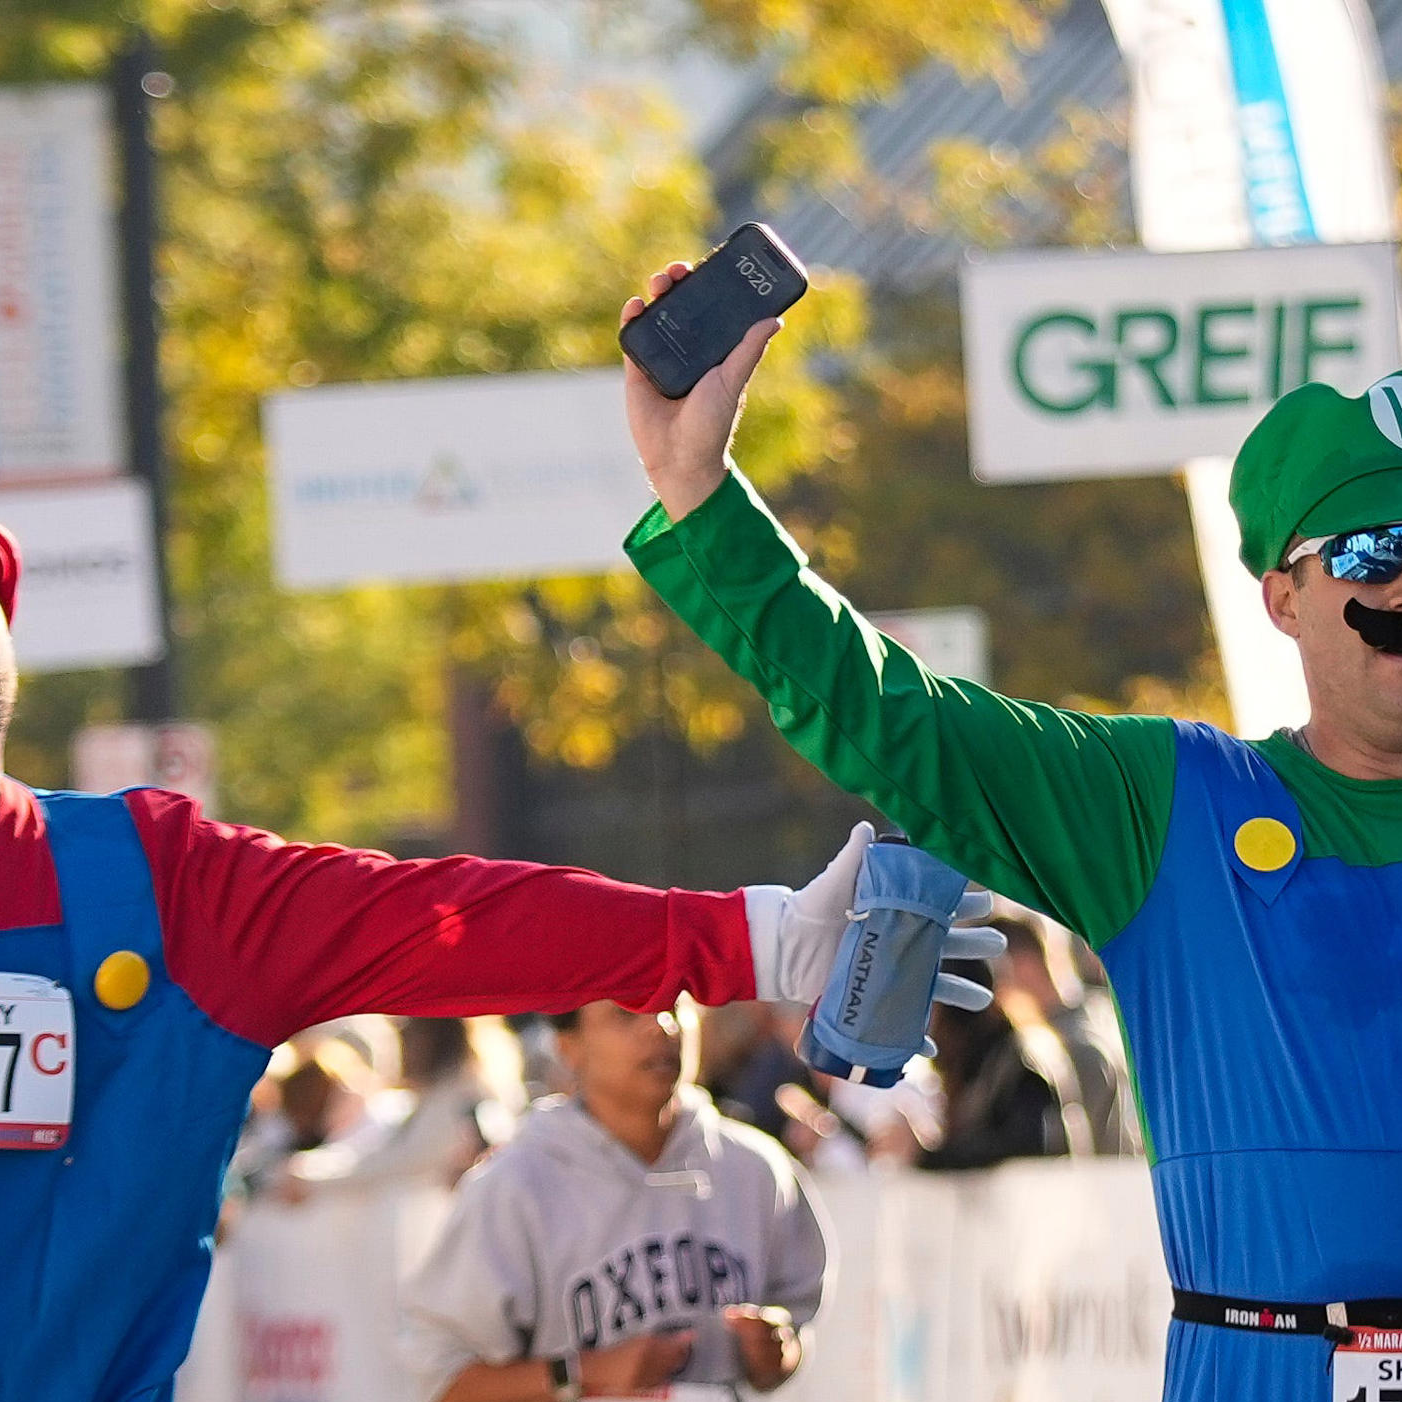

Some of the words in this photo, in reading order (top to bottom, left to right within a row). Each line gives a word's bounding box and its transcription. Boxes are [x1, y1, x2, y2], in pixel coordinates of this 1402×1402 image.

[735, 255, 773, 296] 10:20
[1010, 299, 1361, 413] GREIF
[842, 931, 879, 1027] NATHAN
[30, 1033, 67, 1075] C
[1224, 1307, 1297, 1329] IRONMAN
